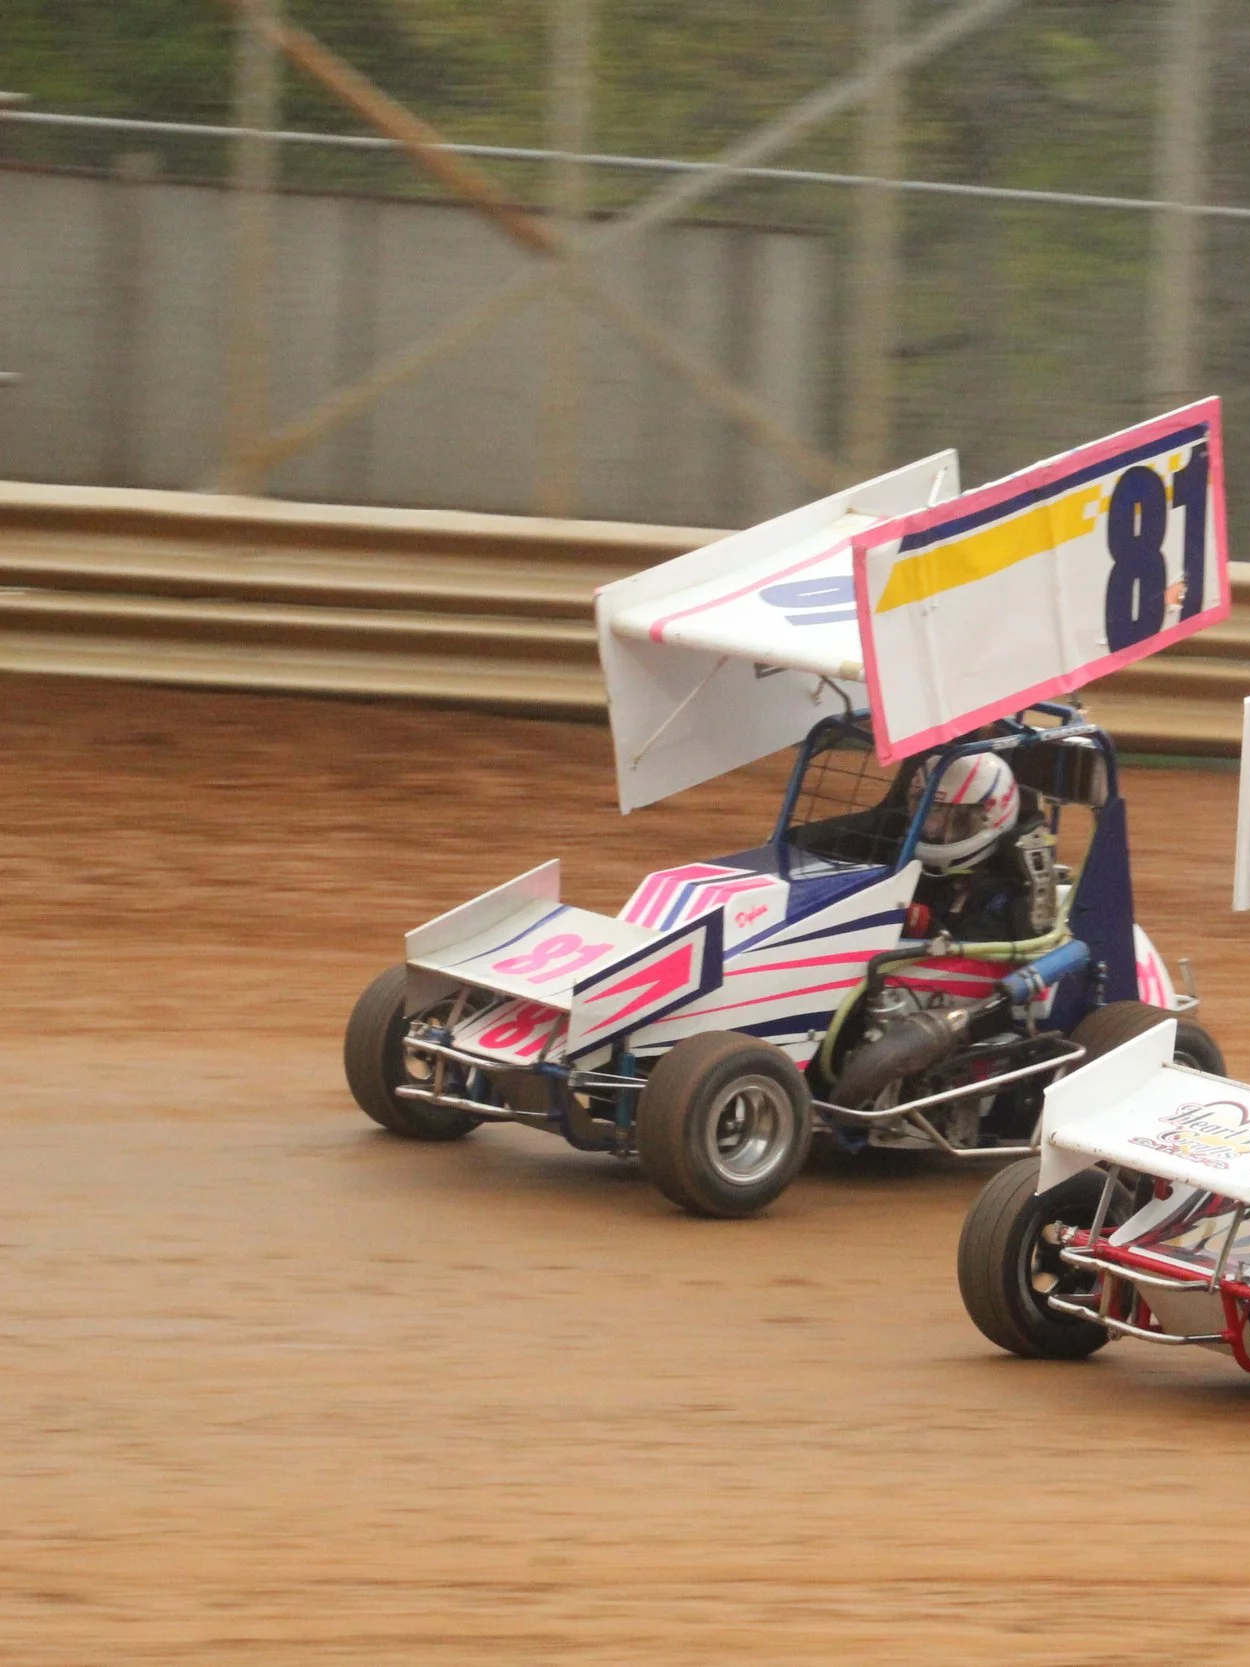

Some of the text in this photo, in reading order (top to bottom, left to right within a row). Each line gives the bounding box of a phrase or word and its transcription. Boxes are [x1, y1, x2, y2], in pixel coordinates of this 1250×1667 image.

[1105, 441, 1209, 653] 81
[491, 932, 615, 985] 81
[1167, 1103, 1248, 1140] Heart
